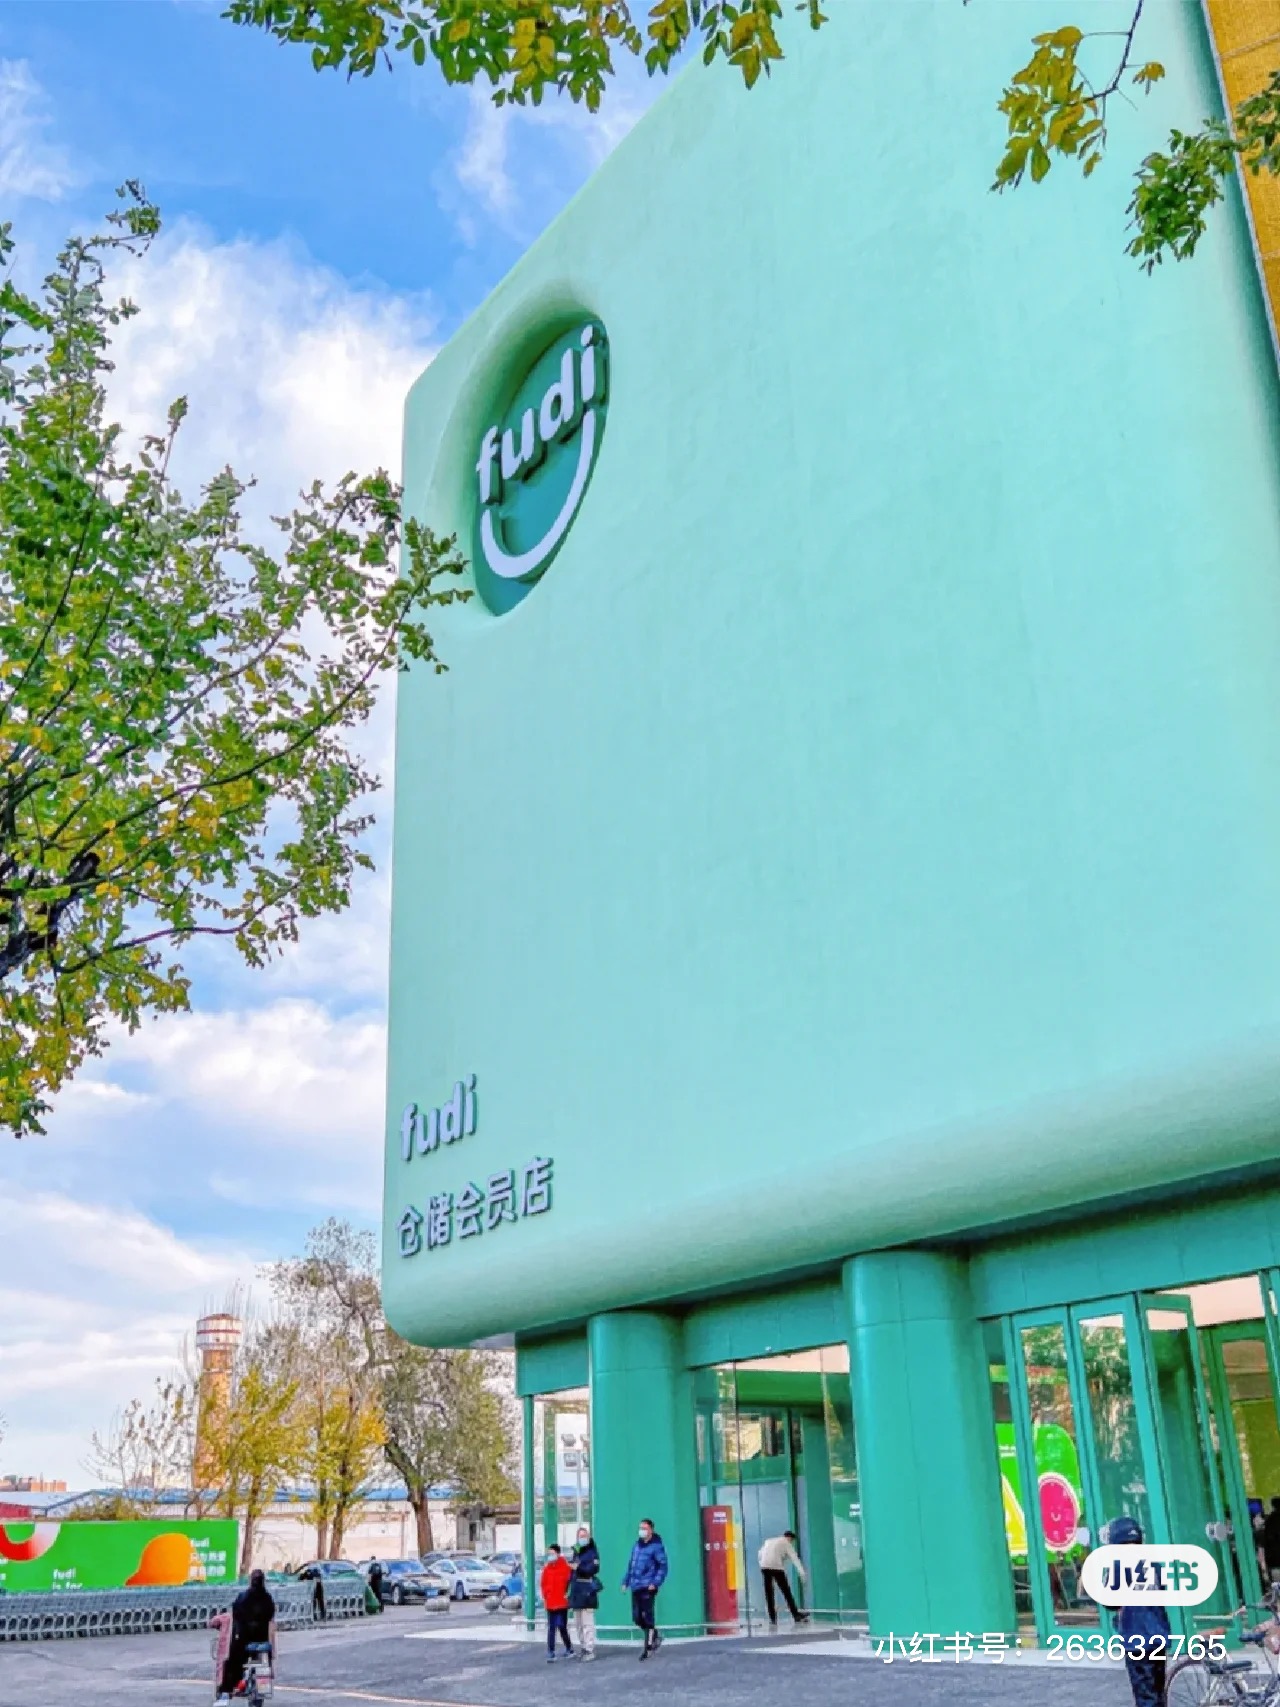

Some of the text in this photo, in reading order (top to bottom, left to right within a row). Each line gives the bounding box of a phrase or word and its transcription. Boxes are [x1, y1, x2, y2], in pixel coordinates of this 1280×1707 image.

[476, 324, 596, 504] fudi
[400, 1072, 477, 1163] fudi
[397, 1156, 554, 1259] 仓储会员店
[53, 1567, 77, 1580] fudi
